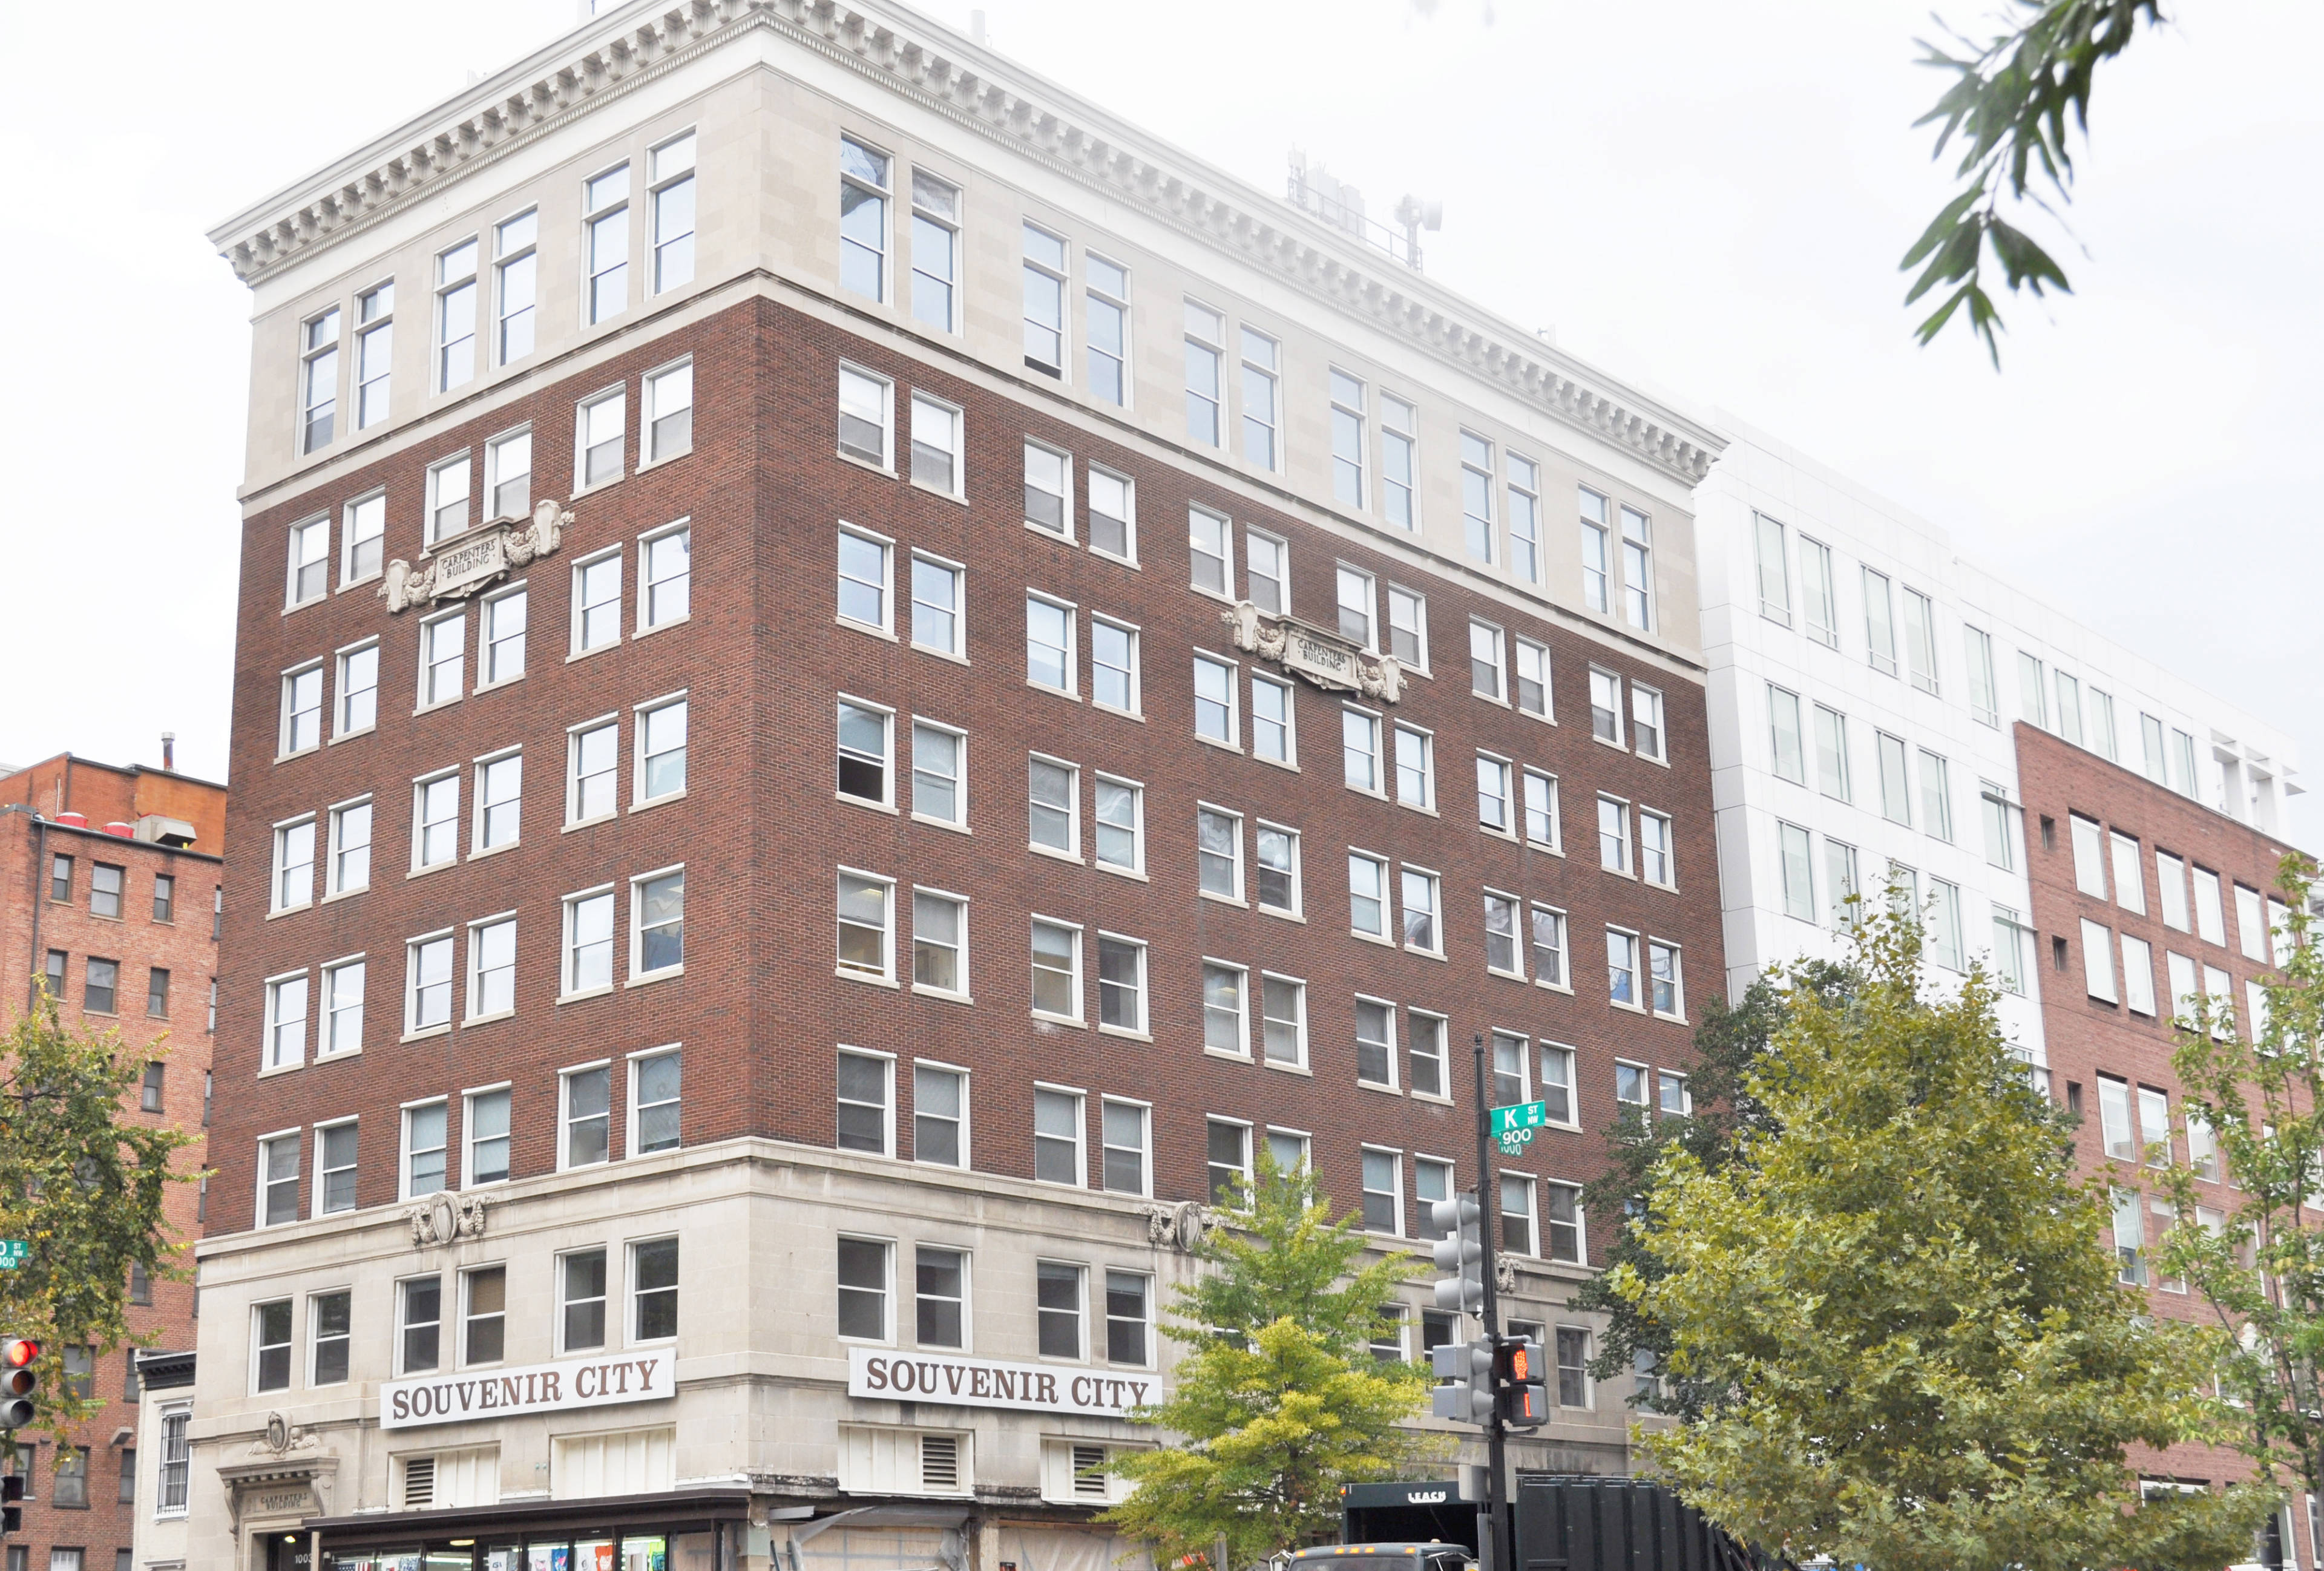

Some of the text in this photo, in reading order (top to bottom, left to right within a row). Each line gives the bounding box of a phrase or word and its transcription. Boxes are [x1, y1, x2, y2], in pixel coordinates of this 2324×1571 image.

[442, 541, 495, 569] CARPENTERS
[447, 554, 490, 579] BUILDING
[1298, 638, 1345, 664] CARPENTERS
[1303, 649, 1342, 672] BUILDING
[1505, 1109, 1518, 1129] K
[1528, 1105, 1538, 1115] ST
[1528, 1115, 1538, 1125] NW
[1502, 1128, 1532, 1145] 900
[392, 1359, 658, 1420] SOUVENIR CITY
[867, 1357, 1149, 1409] SOUVENIR CITY
[261, 1492, 307, 1504] CARPENTERS
[267, 1500, 301, 1510] BUILDING
[1408, 1491, 1446, 1504] LEACH
